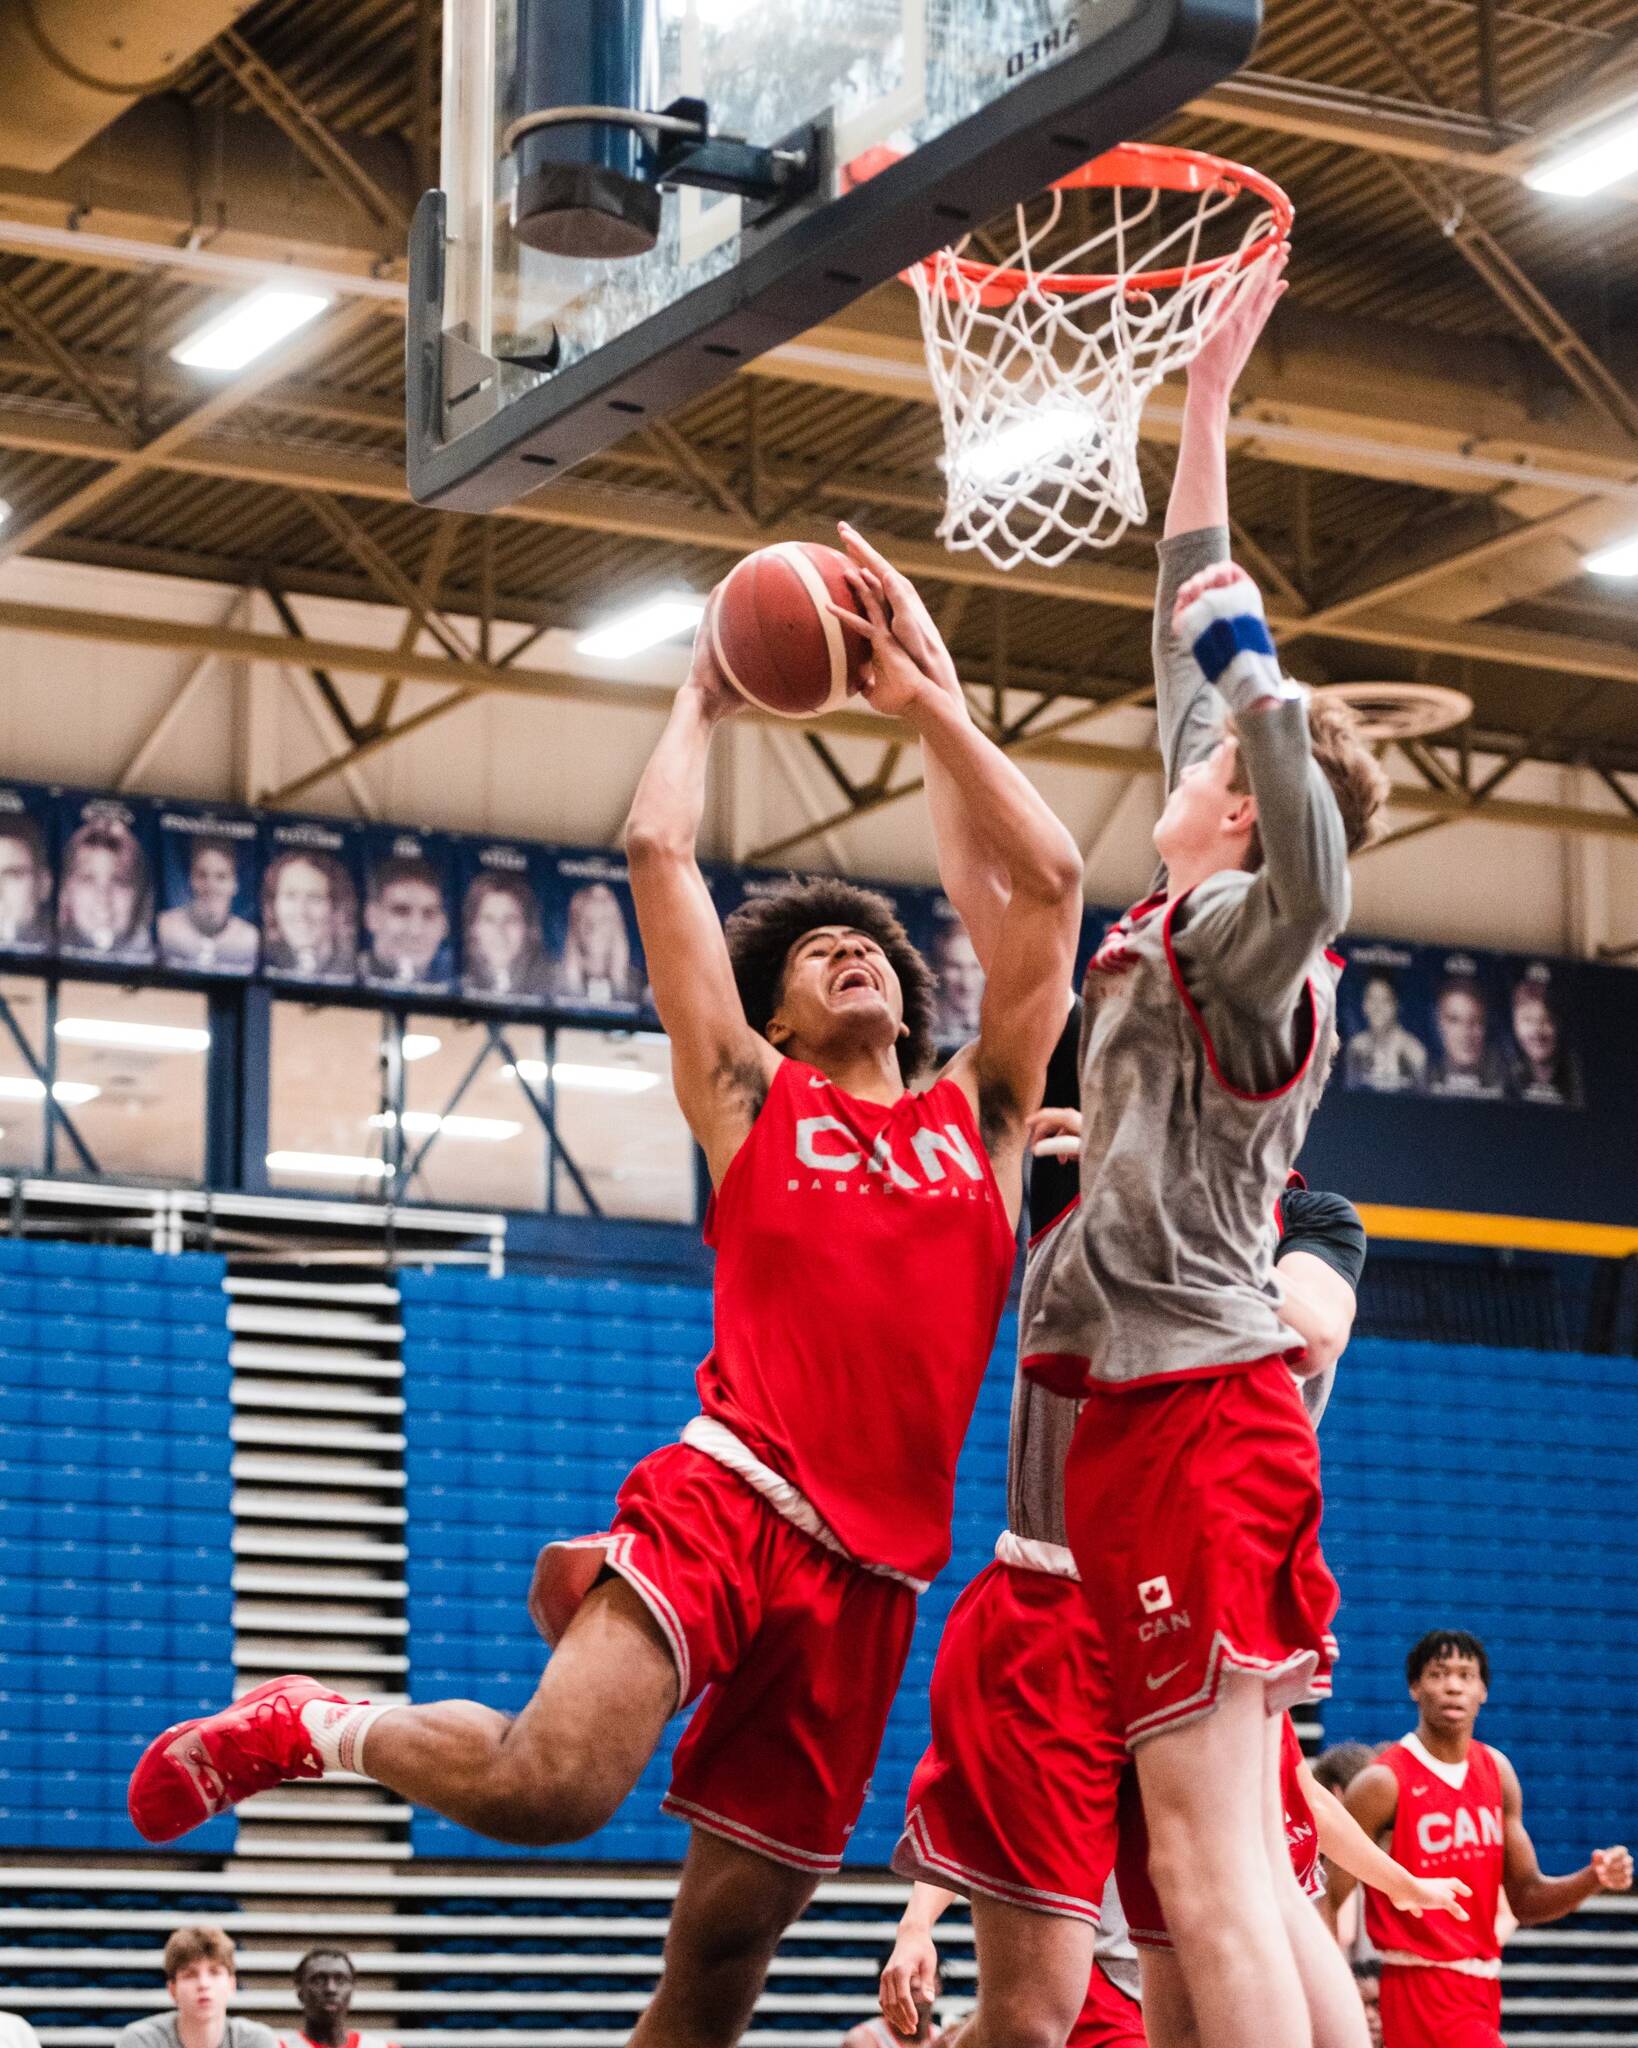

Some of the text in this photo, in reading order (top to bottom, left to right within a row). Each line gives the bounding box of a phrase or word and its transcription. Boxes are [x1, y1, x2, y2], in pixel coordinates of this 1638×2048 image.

[795, 1115, 984, 1189] CAN
[787, 1178, 991, 1202] BASKEALL
[1138, 1609, 1191, 1642] CAN
[1416, 1805, 1504, 1854] CAN
